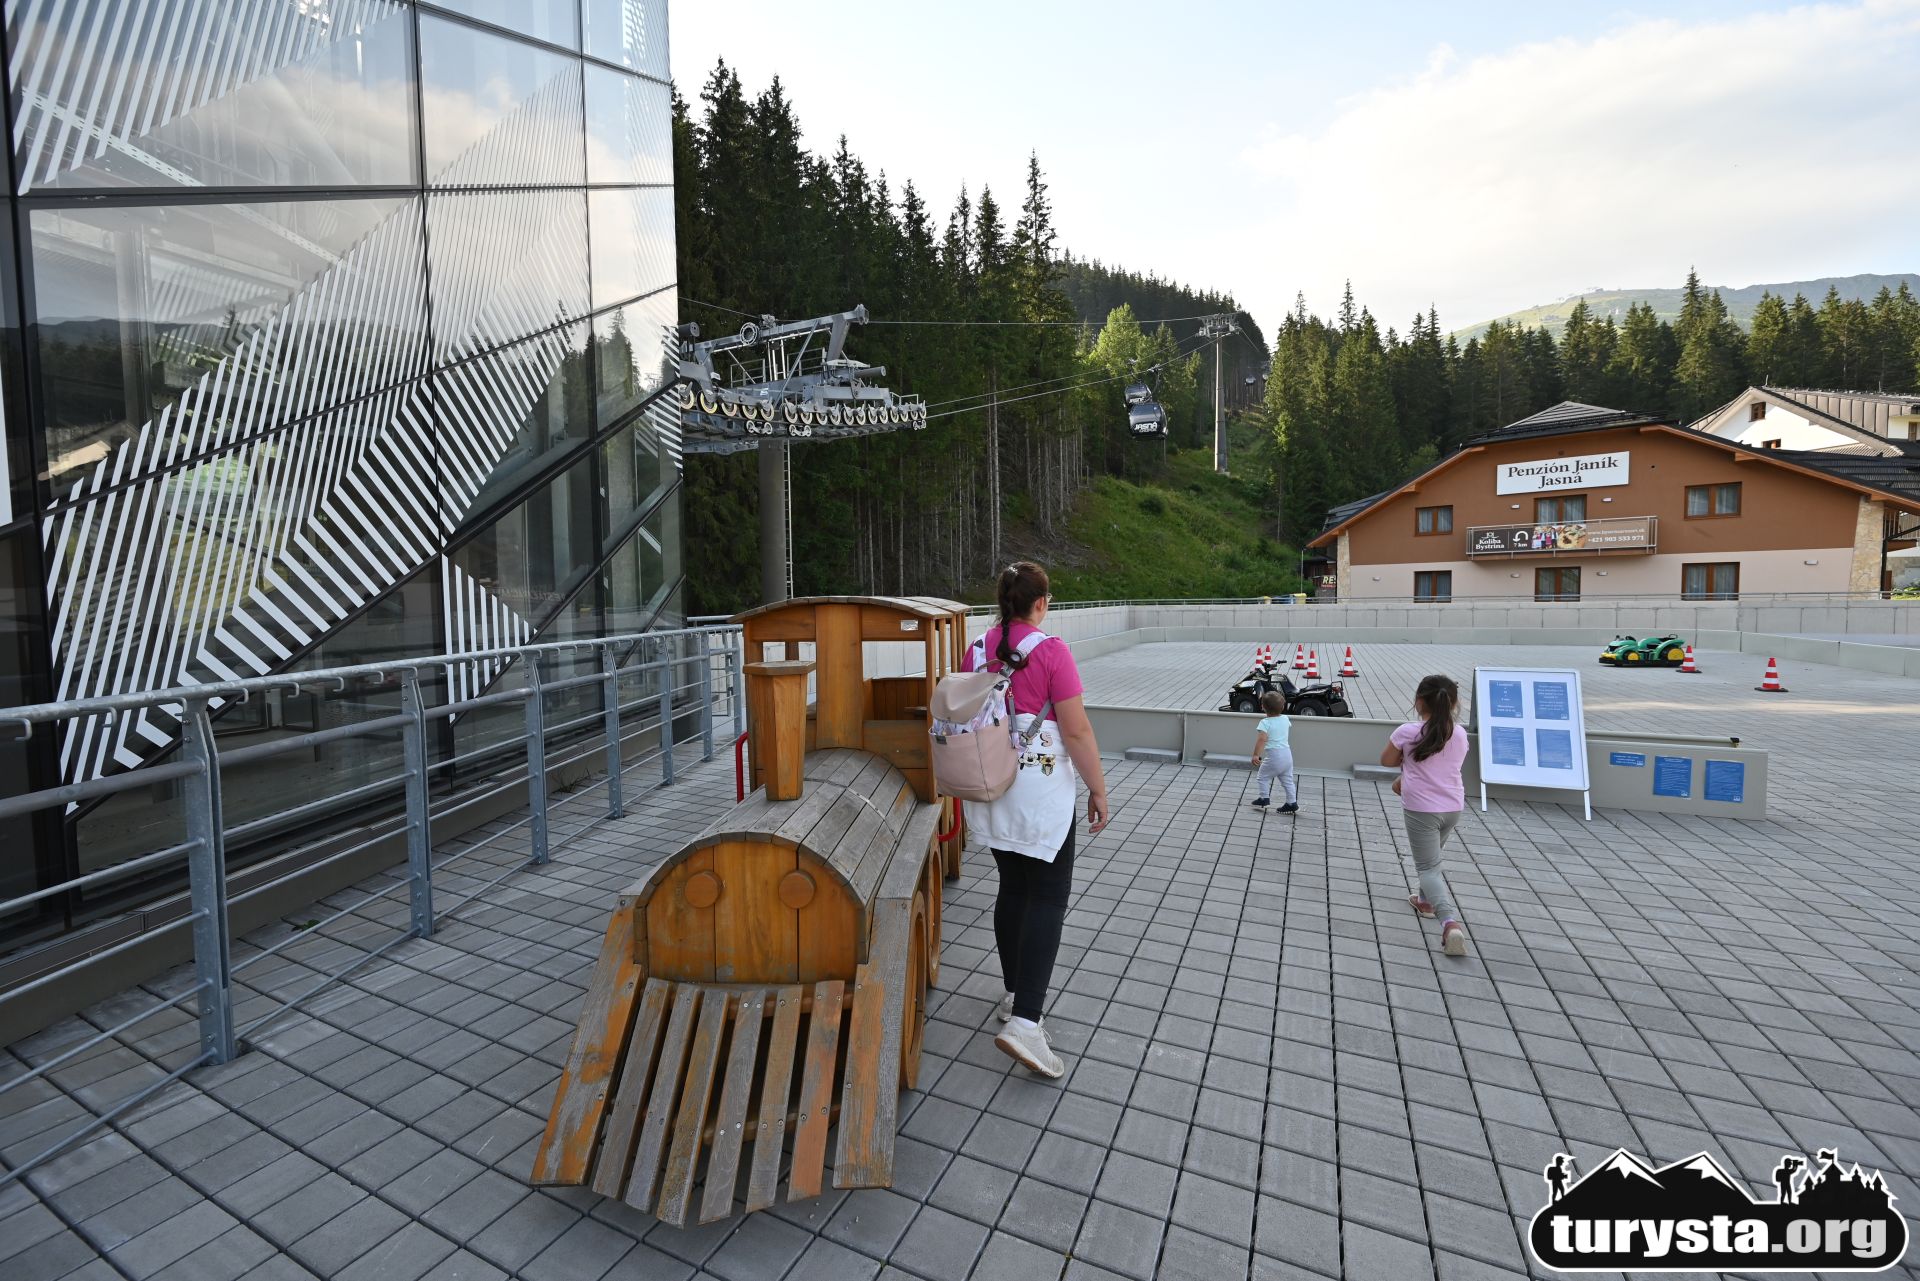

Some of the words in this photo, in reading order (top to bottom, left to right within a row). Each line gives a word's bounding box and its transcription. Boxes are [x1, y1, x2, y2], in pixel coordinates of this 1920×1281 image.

[1508, 462, 1569, 478] Penzión
[1572, 456, 1620, 473] Janík
[1538, 472, 1582, 489] Jasná
[1475, 543, 1505, 551] Bystrina
